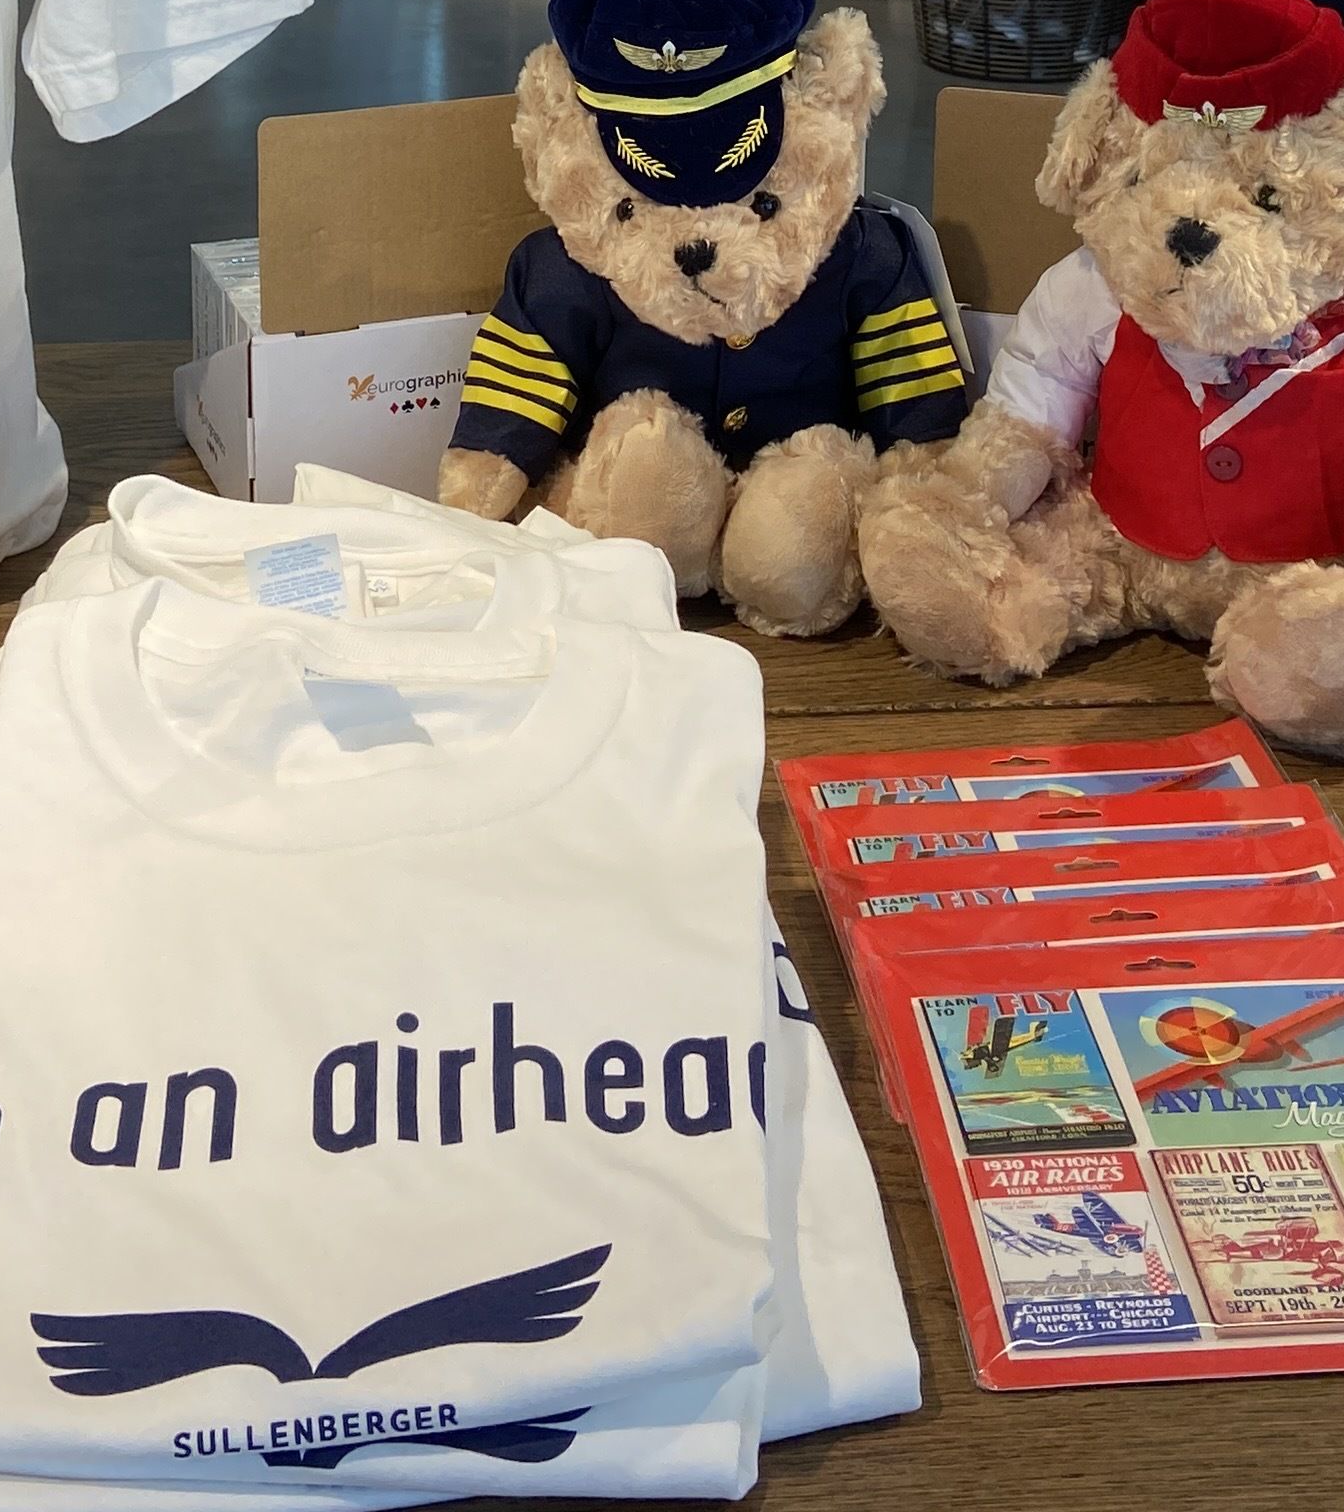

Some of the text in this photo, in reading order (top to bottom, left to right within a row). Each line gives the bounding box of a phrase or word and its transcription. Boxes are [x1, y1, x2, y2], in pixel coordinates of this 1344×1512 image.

[367, 368, 467, 394] eurographic
[822, 775, 947, 794] LEARN FLY
[857, 832, 989, 852] LEARN FLY
[872, 887, 1009, 909] LEARN FLY
[926, 990, 1074, 1016] LEARN FLY
[936, 1008, 955, 1017] TO
[69, 1065, 239, 1171] an
[983, 1156, 1123, 1171] 1930 NATIONAL
[1164, 1149, 1321, 1175] AIRPLANE RIDES
[990, 1166, 1125, 1187] AIR RACES
[1035, 1184, 1113, 1194] ANNIVERSARY
[1234, 1287, 1313, 1297] GOODLAND,
[1022, 1298, 1172, 1314] CURTISS REYNOLDS
[1110, 1308, 1175, 1319] CHICAGO
[1226, 1300, 1273, 1314] SEPT.
[1280, 1298, 1316, 1310] 19th
[1077, 1321, 1094, 1331] 23
[1098, 1320, 1116, 1329] TO
[172, 1402, 460, 1461] SULLENBERGER
